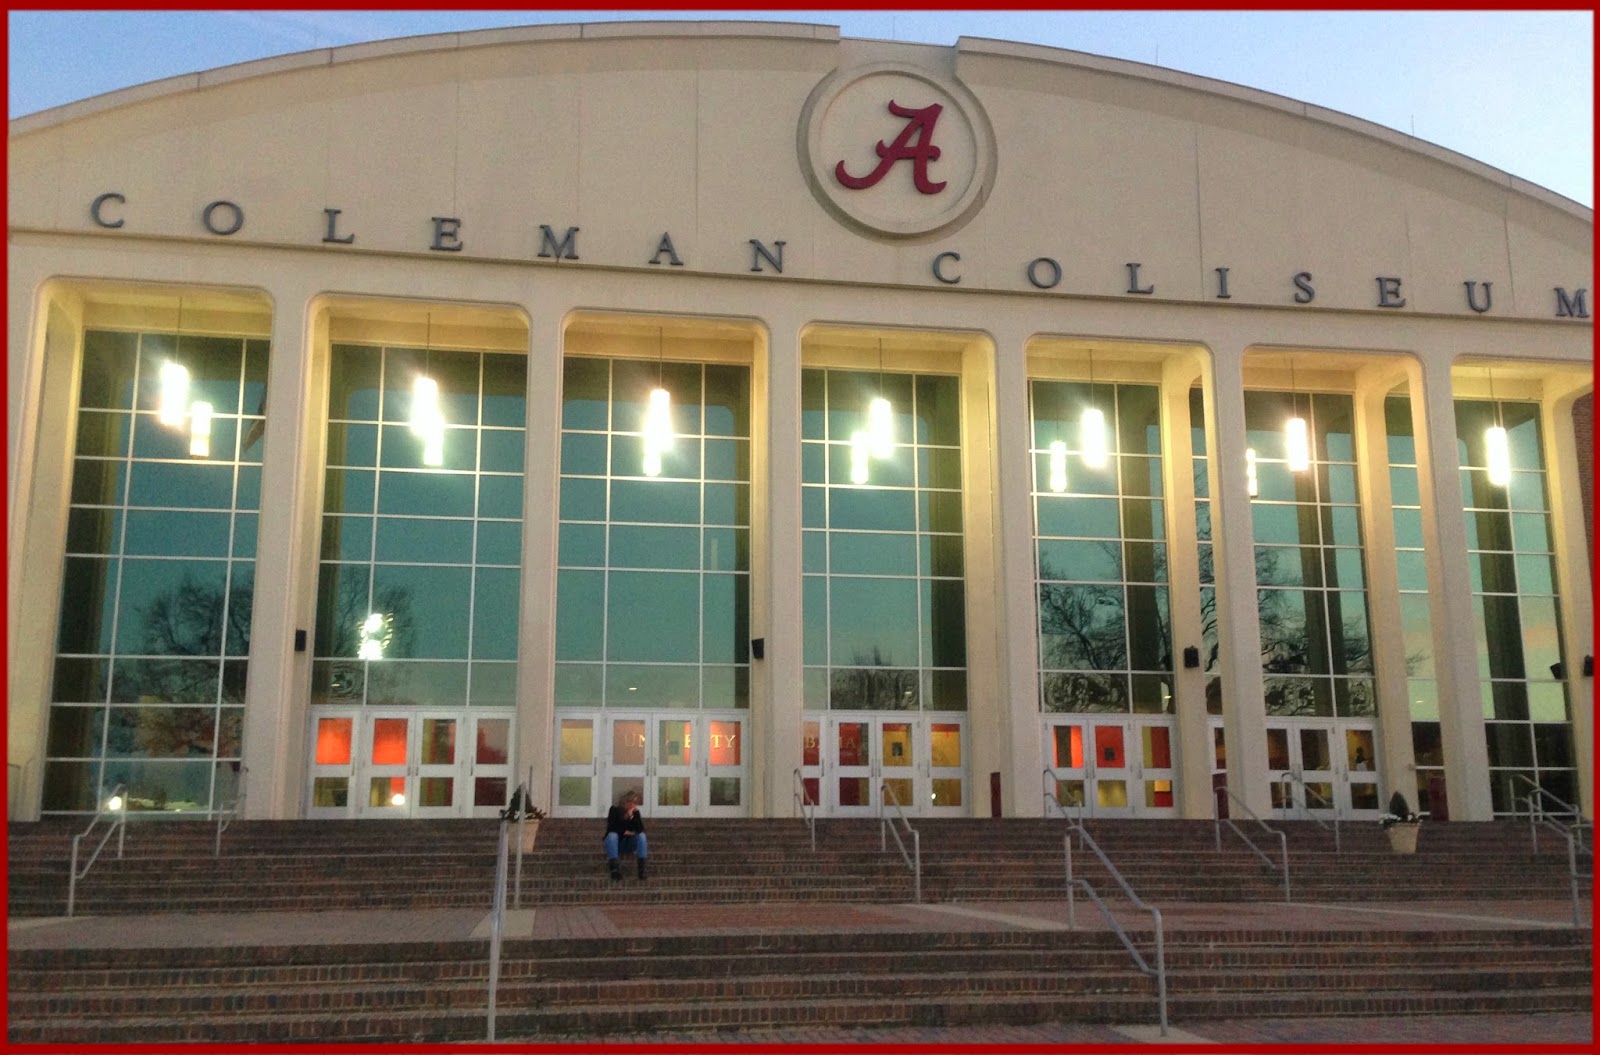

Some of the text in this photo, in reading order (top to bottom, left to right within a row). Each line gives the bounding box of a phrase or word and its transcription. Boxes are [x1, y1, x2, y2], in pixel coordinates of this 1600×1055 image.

[835, 99, 947, 195] A
[91, 192, 1591, 318] COLEMAN COLISEUM
